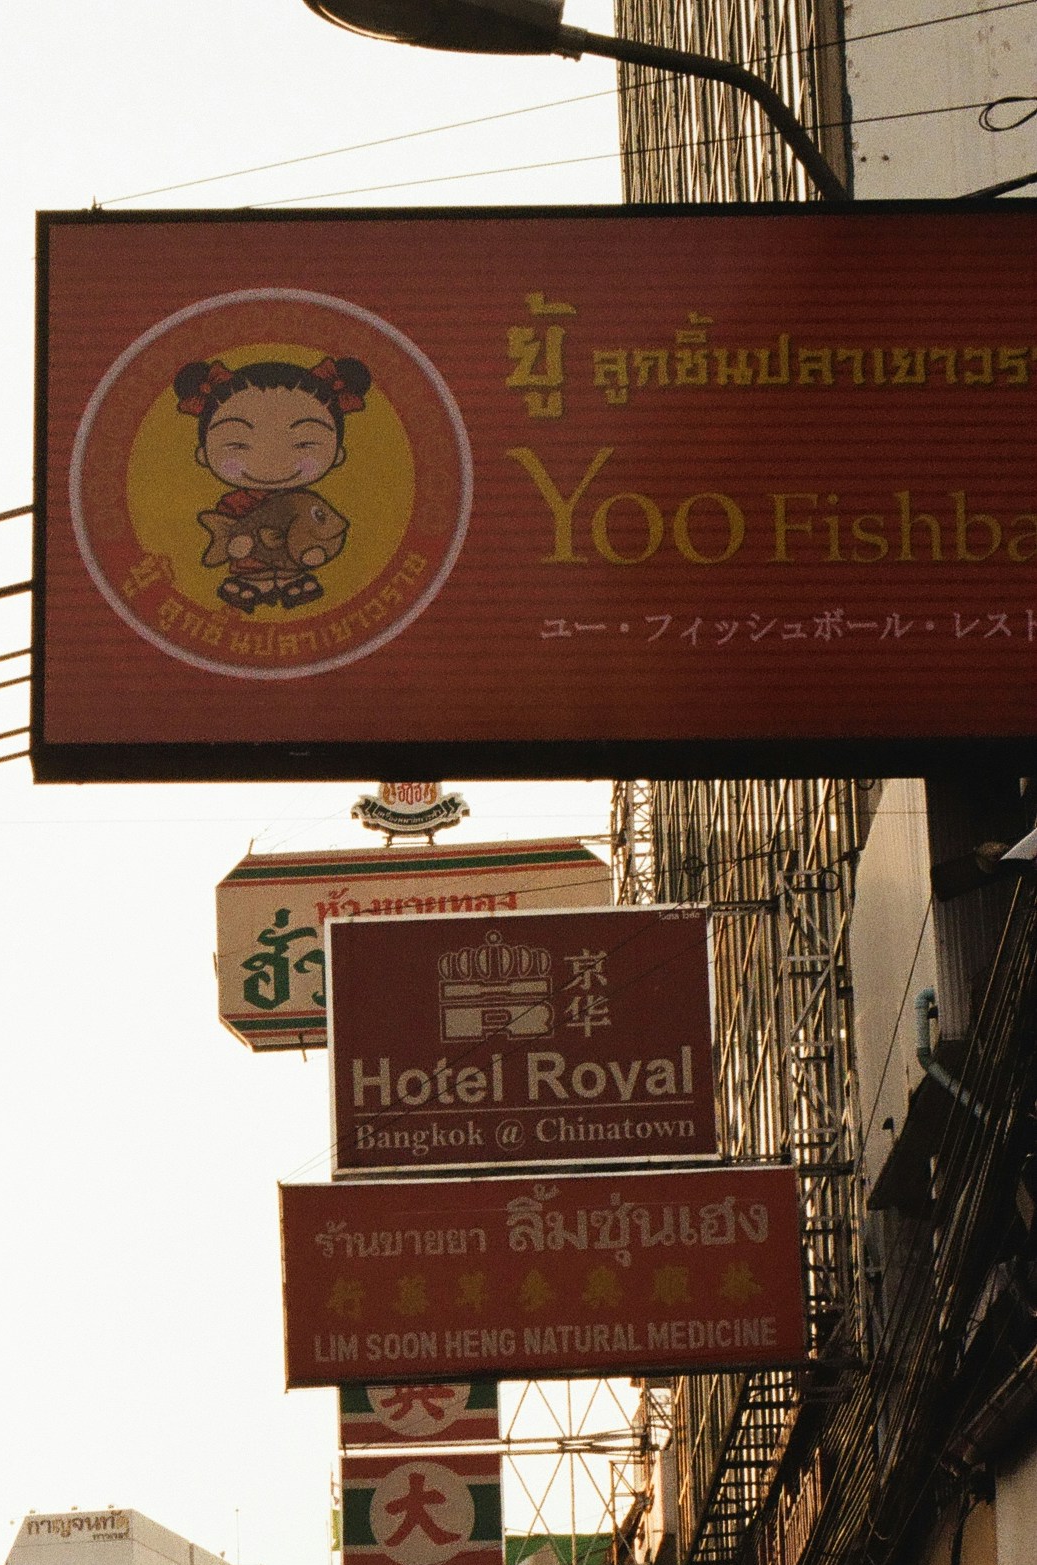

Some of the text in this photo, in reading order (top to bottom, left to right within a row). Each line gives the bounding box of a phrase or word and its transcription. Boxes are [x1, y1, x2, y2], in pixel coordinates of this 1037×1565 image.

[592, 313, 1037, 404] ลูกชิ้นปลาเยาวร
[352, 1045, 694, 1107] Hotel Royal
[355, 1116, 696, 1156] Bangkok @ Chinatown
[314, 1316, 777, 1363] LIM SOON HENG NATURAL MEDICINE
